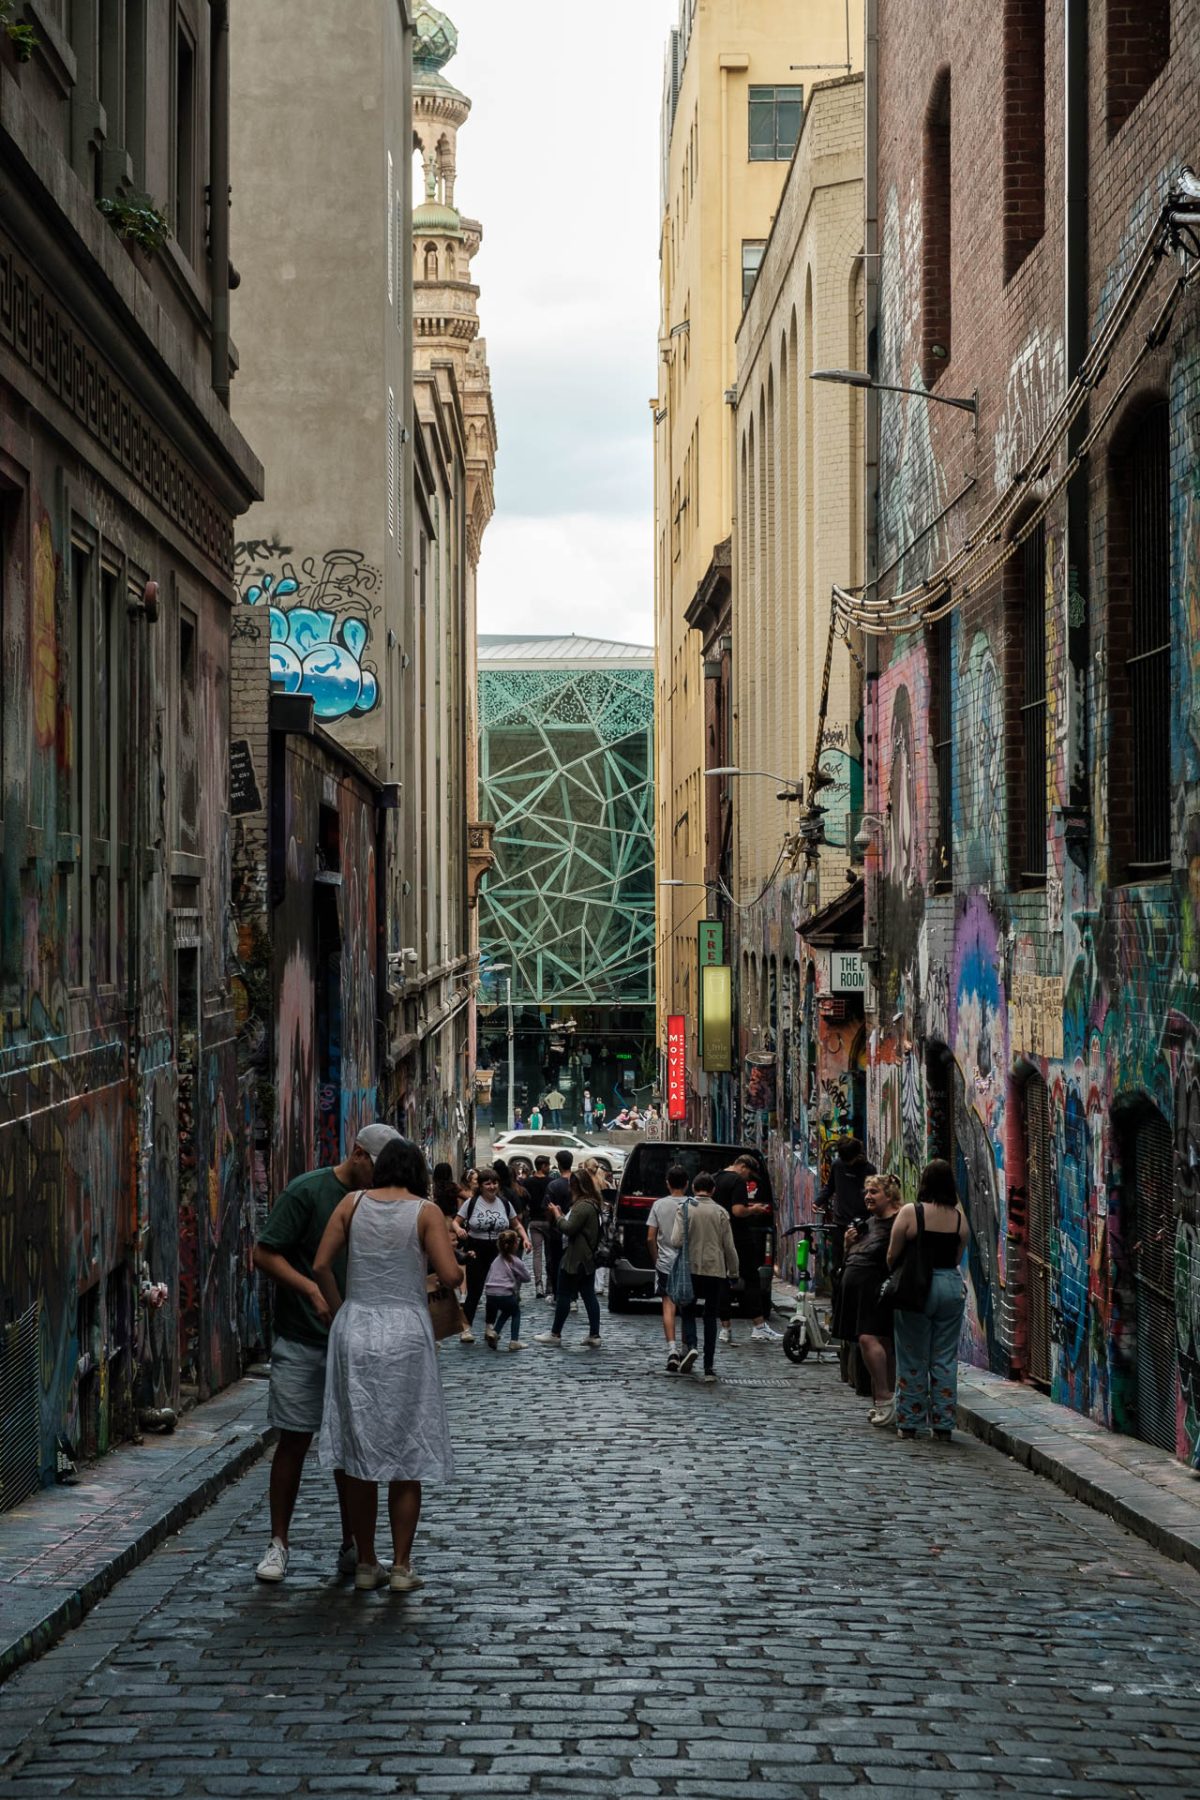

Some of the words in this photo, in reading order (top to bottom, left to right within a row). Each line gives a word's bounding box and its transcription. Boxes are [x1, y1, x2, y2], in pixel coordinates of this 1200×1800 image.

[706, 929, 716, 966] TRE
[840, 957, 858, 971] THE
[669, 1034, 678, 1100] MOVIDA
